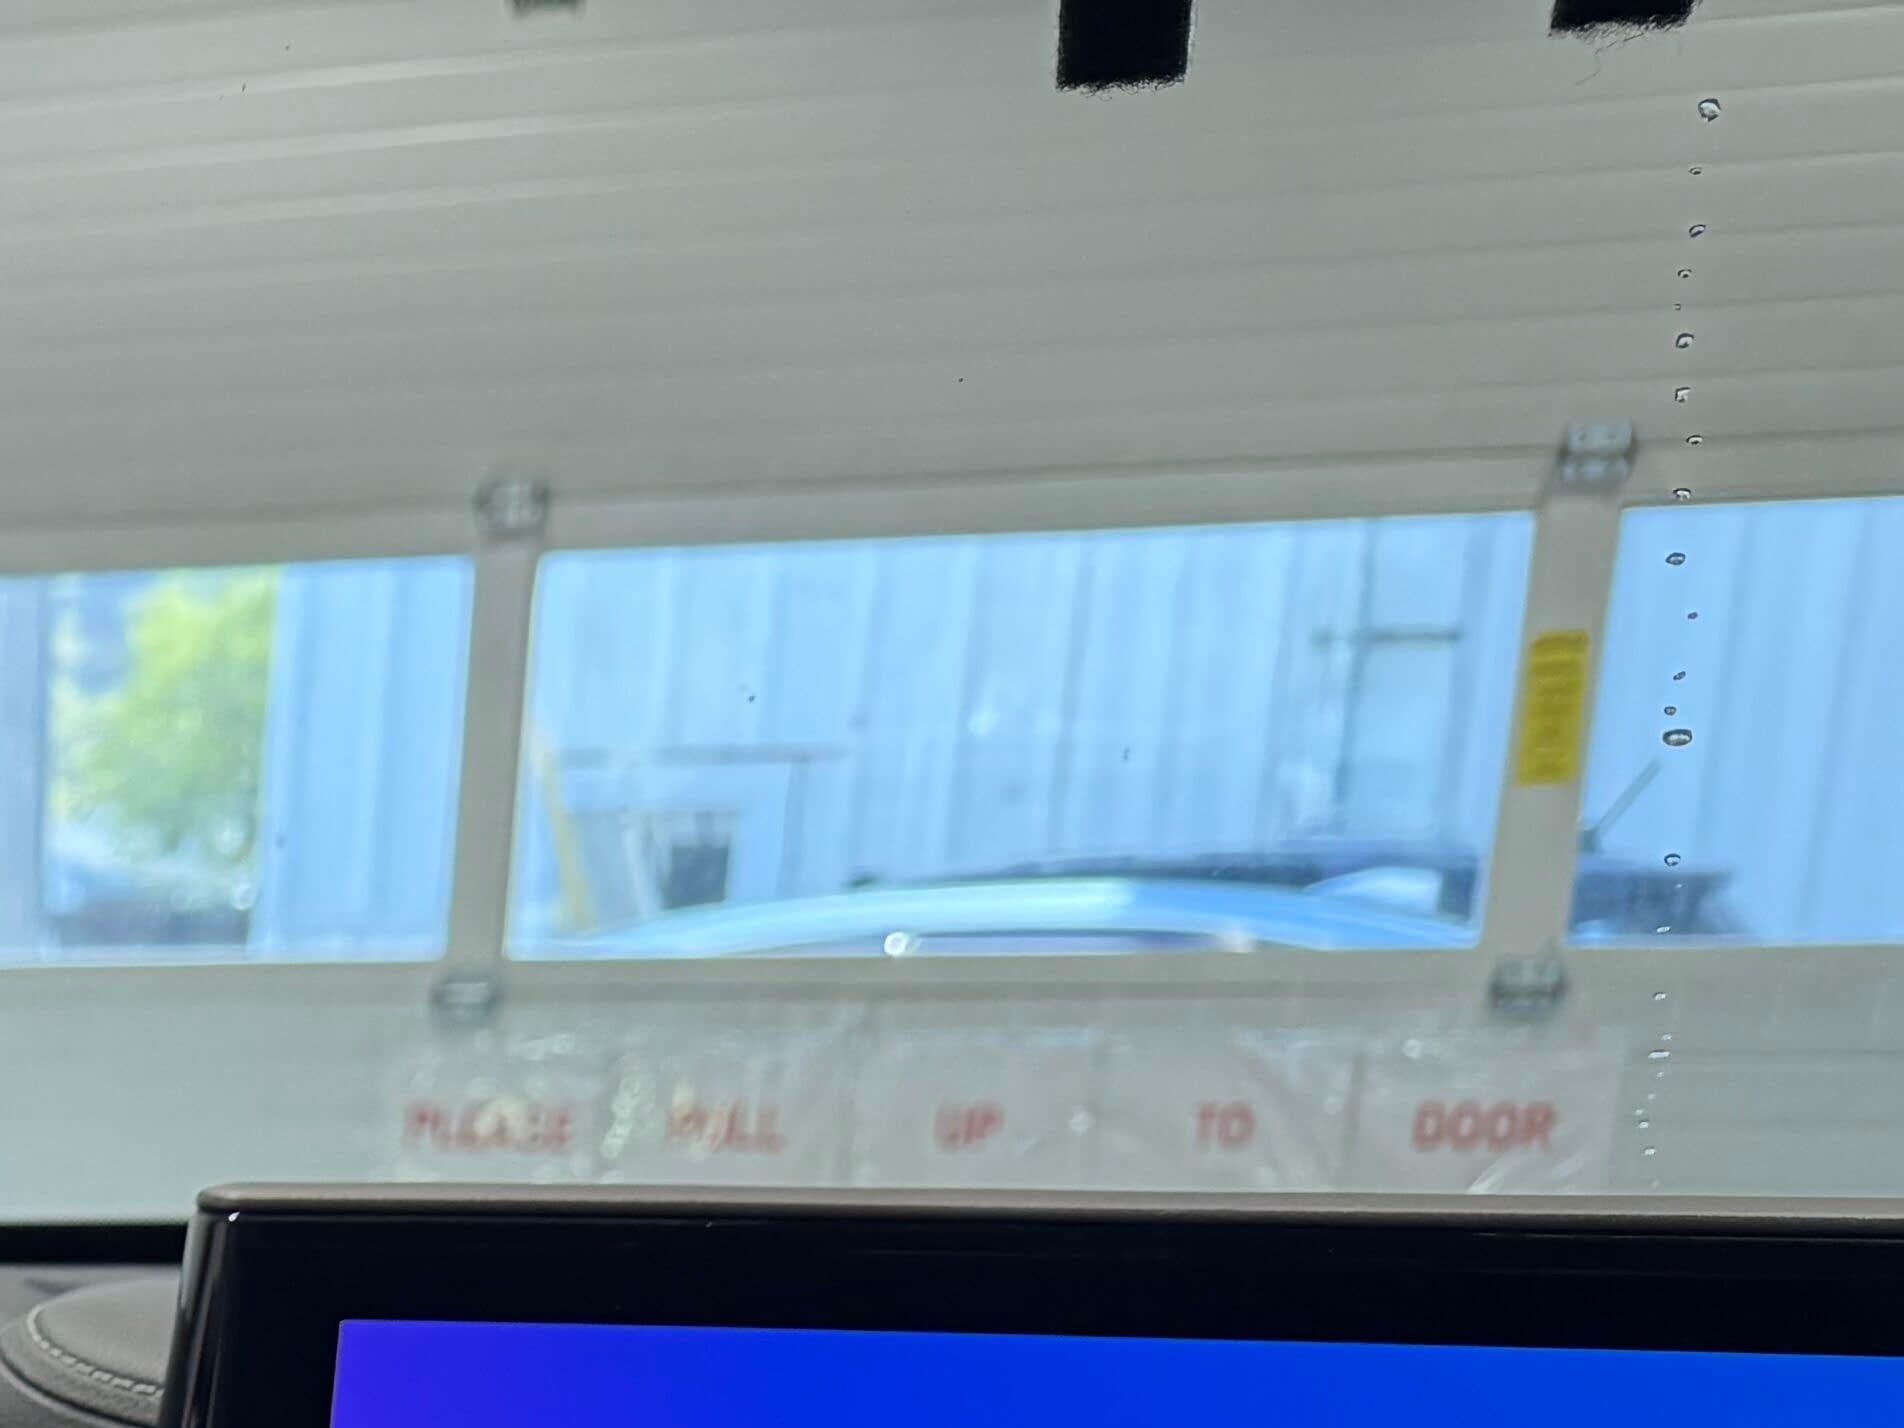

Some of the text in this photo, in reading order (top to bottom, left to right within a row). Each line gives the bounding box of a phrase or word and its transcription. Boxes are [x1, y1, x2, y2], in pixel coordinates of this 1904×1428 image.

[932, 1098, 1005, 1151] UP
[1196, 1101, 1256, 1152] TO
[1411, 1100, 1557, 1152] DOOR
